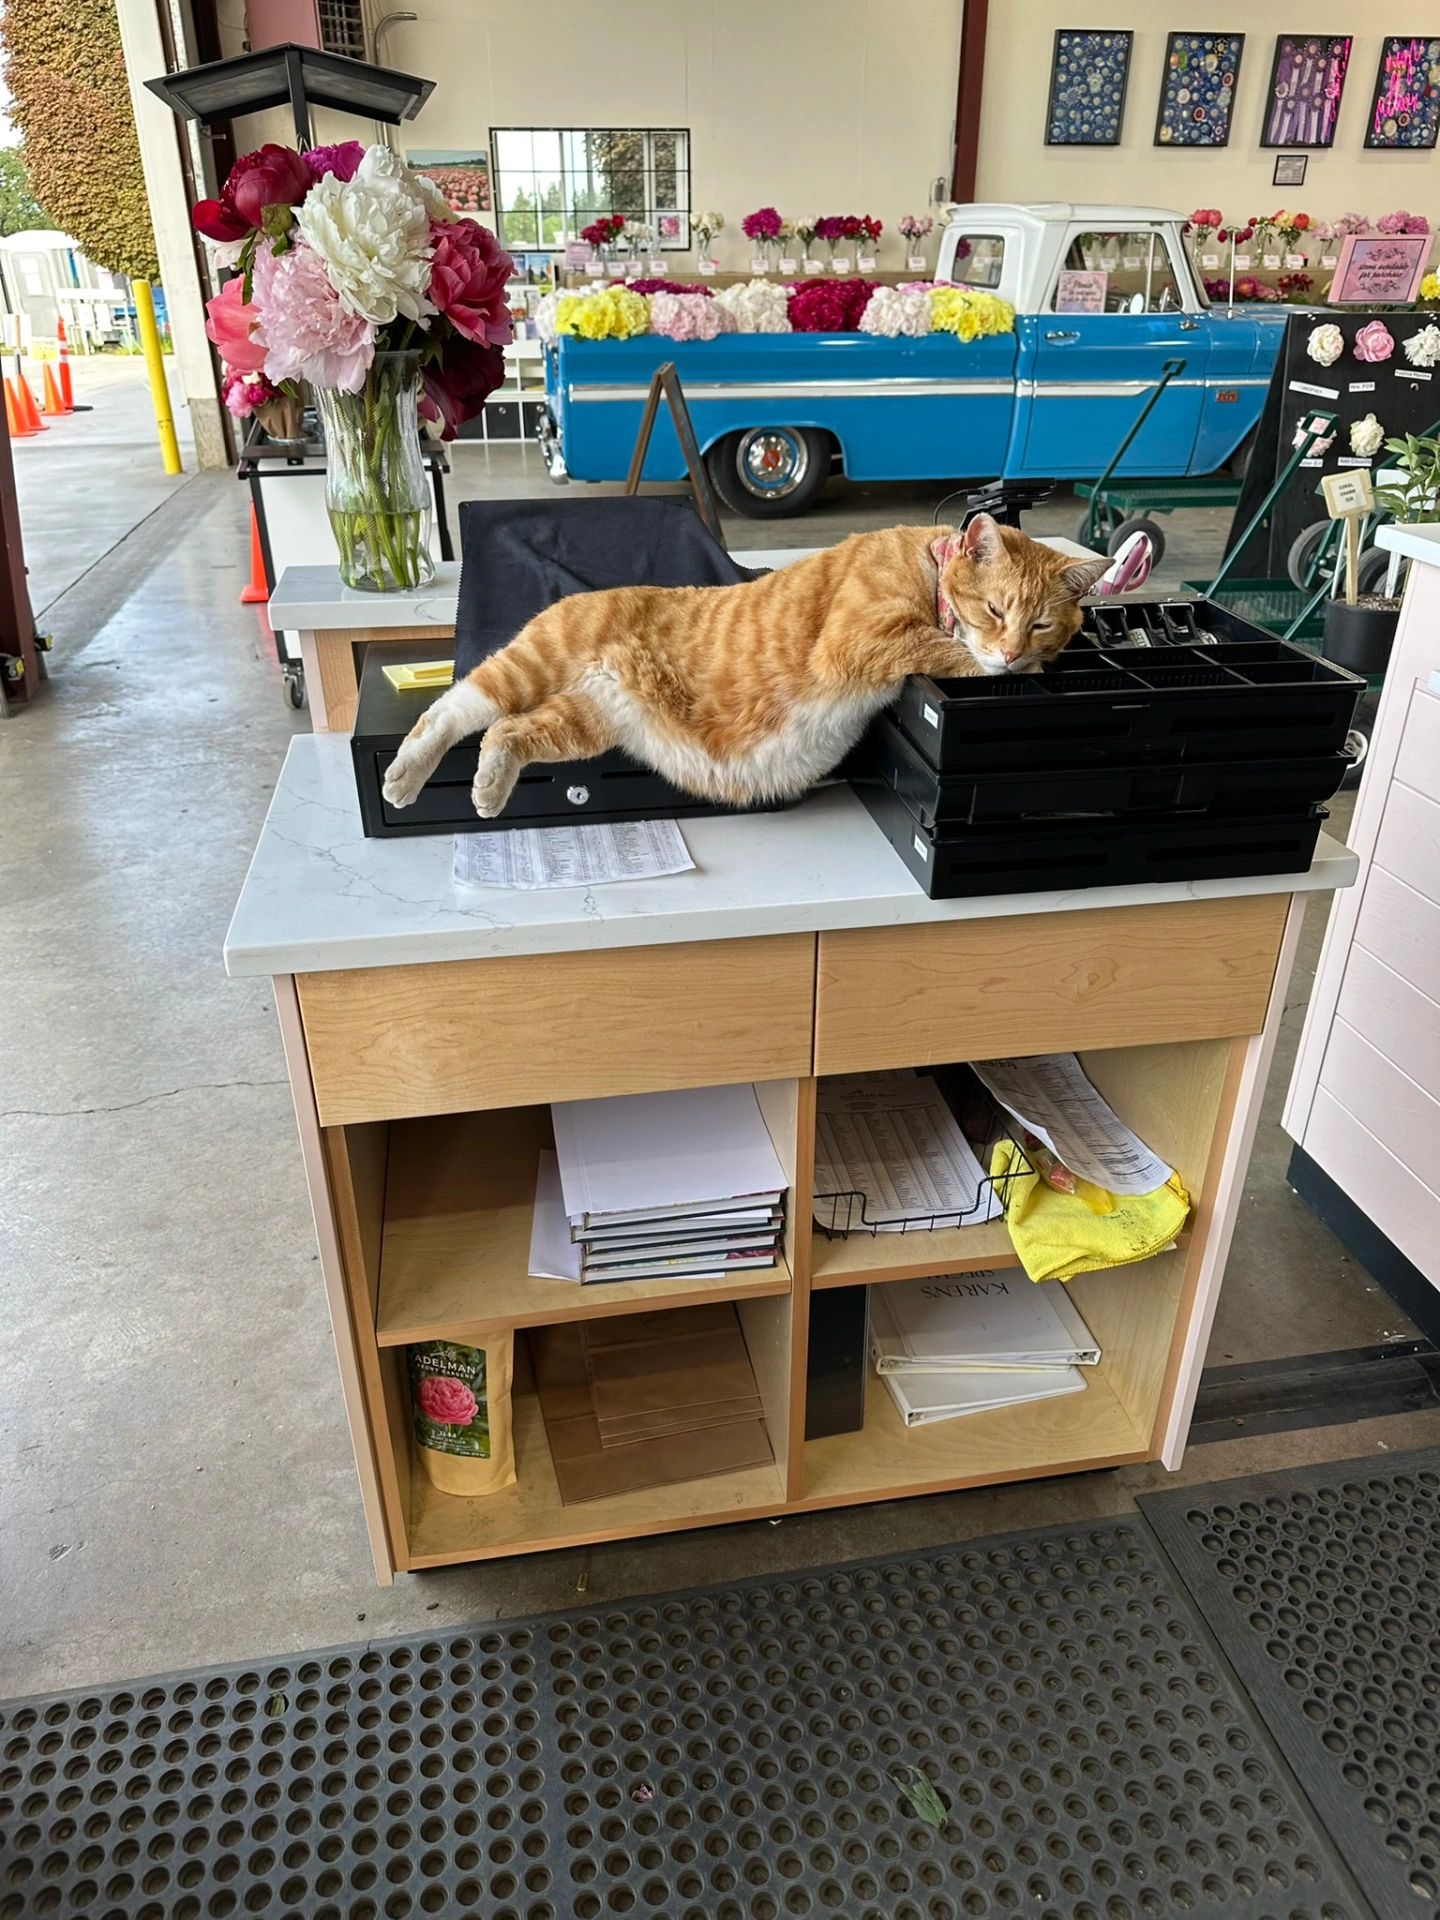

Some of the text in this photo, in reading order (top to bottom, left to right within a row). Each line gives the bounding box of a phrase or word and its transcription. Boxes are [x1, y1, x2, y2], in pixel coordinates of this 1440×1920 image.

[1378, 262, 1409, 270] available
[1370, 271, 1403, 280] purchase
[1340, 489, 1356, 497] CHARM
[927, 1269, 995, 1279] SPEC
[414, 1354, 476, 1375] ADELMAN
[416, 1363, 474, 1380] PEONY GARDENS
